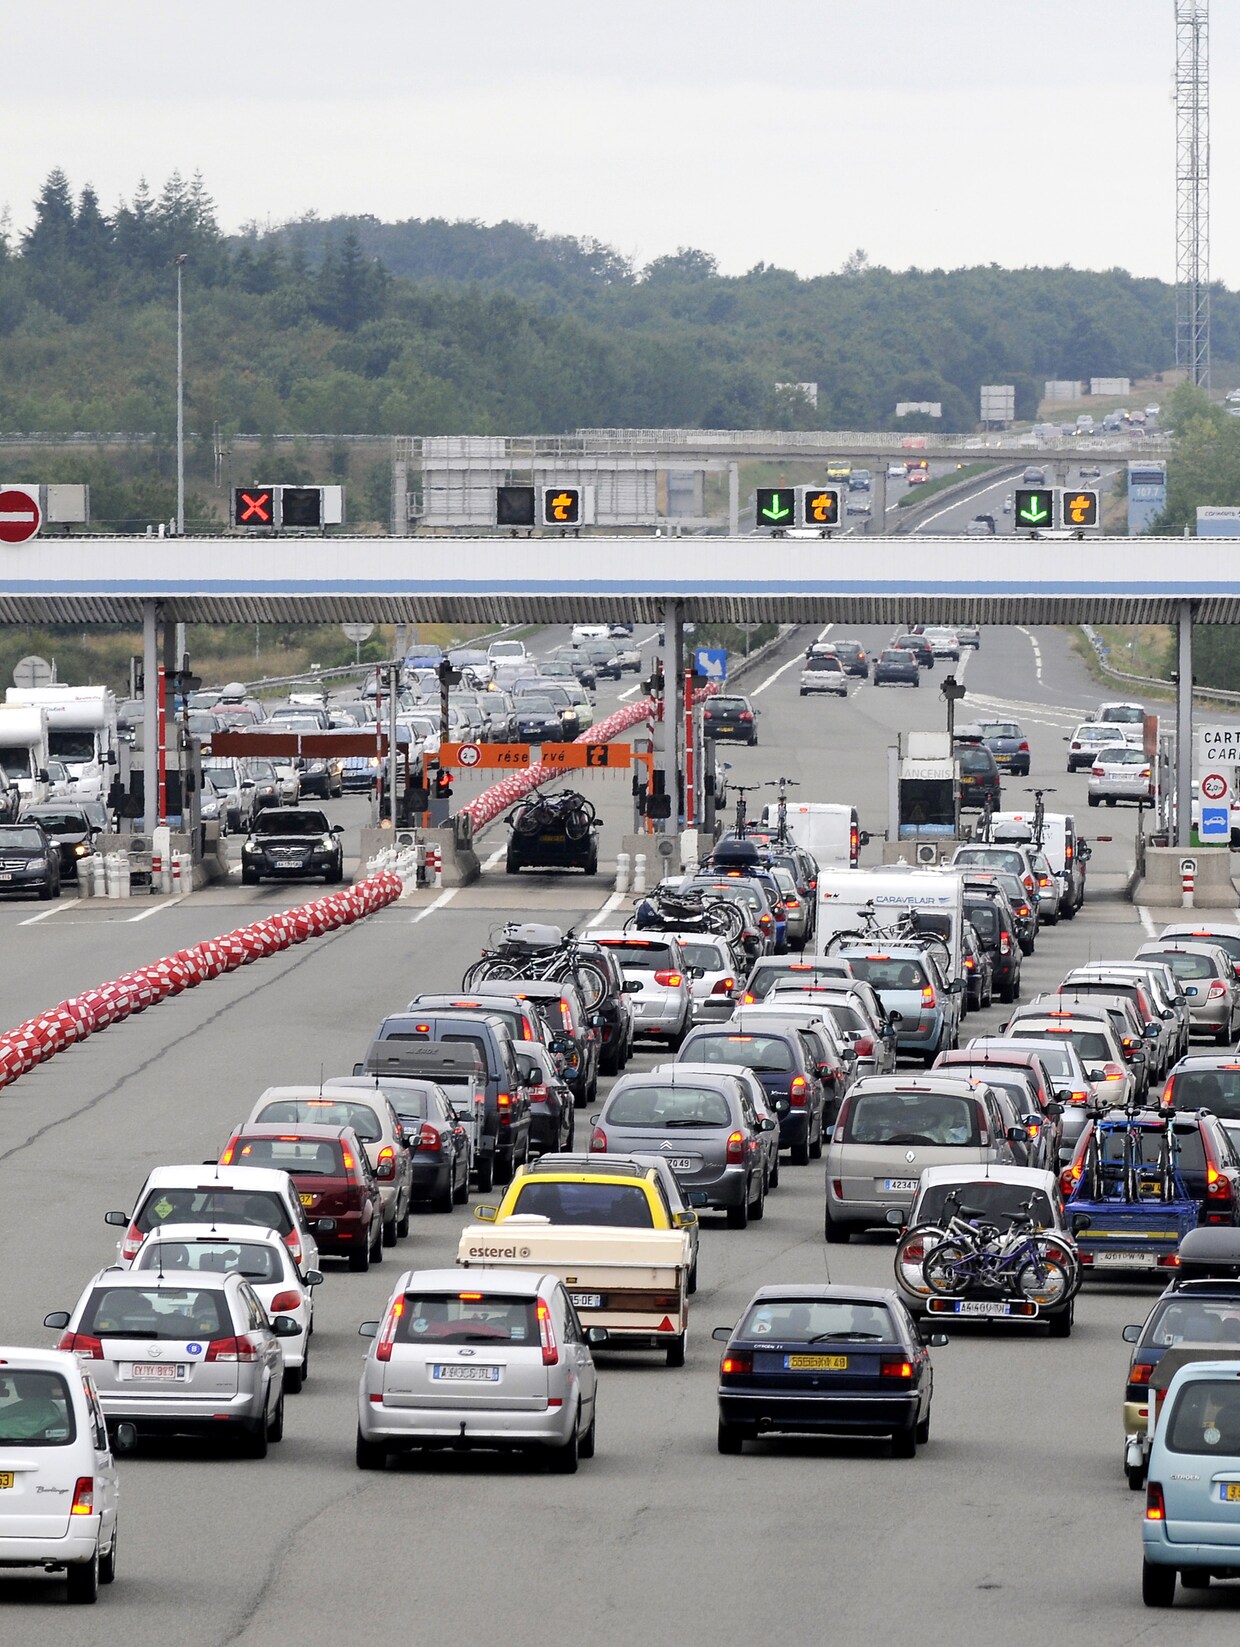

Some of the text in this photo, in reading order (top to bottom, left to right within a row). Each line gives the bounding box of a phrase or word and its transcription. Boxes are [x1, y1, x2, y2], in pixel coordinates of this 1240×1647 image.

[904, 768, 952, 779] ANCENIS
[876, 895, 936, 904] CARAVELAIR
[892, 1181, 912, 1189] 4234
[469, 1246, 517, 1258] esterel
